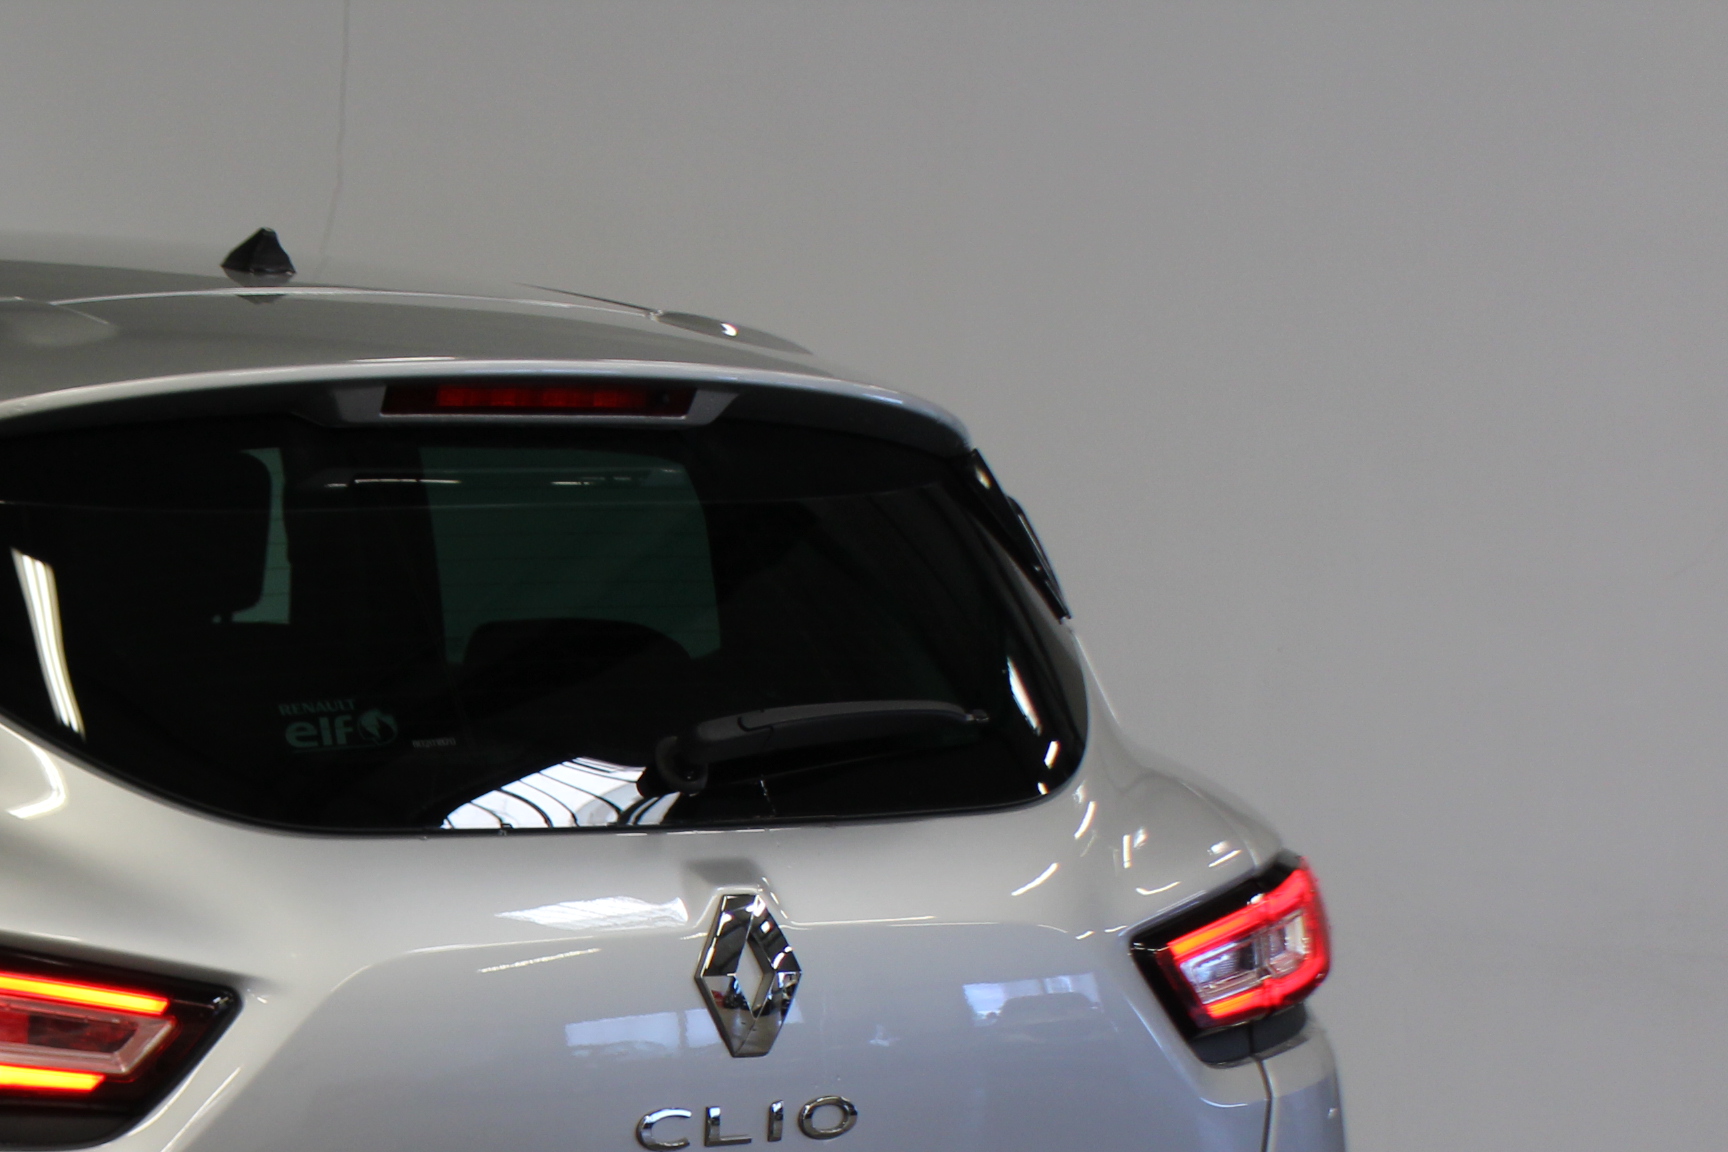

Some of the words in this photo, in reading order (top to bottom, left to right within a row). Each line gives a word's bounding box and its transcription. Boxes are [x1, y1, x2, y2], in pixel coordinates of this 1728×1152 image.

[278, 698, 356, 716] RENAULT
[285, 714, 353, 748] elf
[635, 1095, 858, 1152] CLIO
